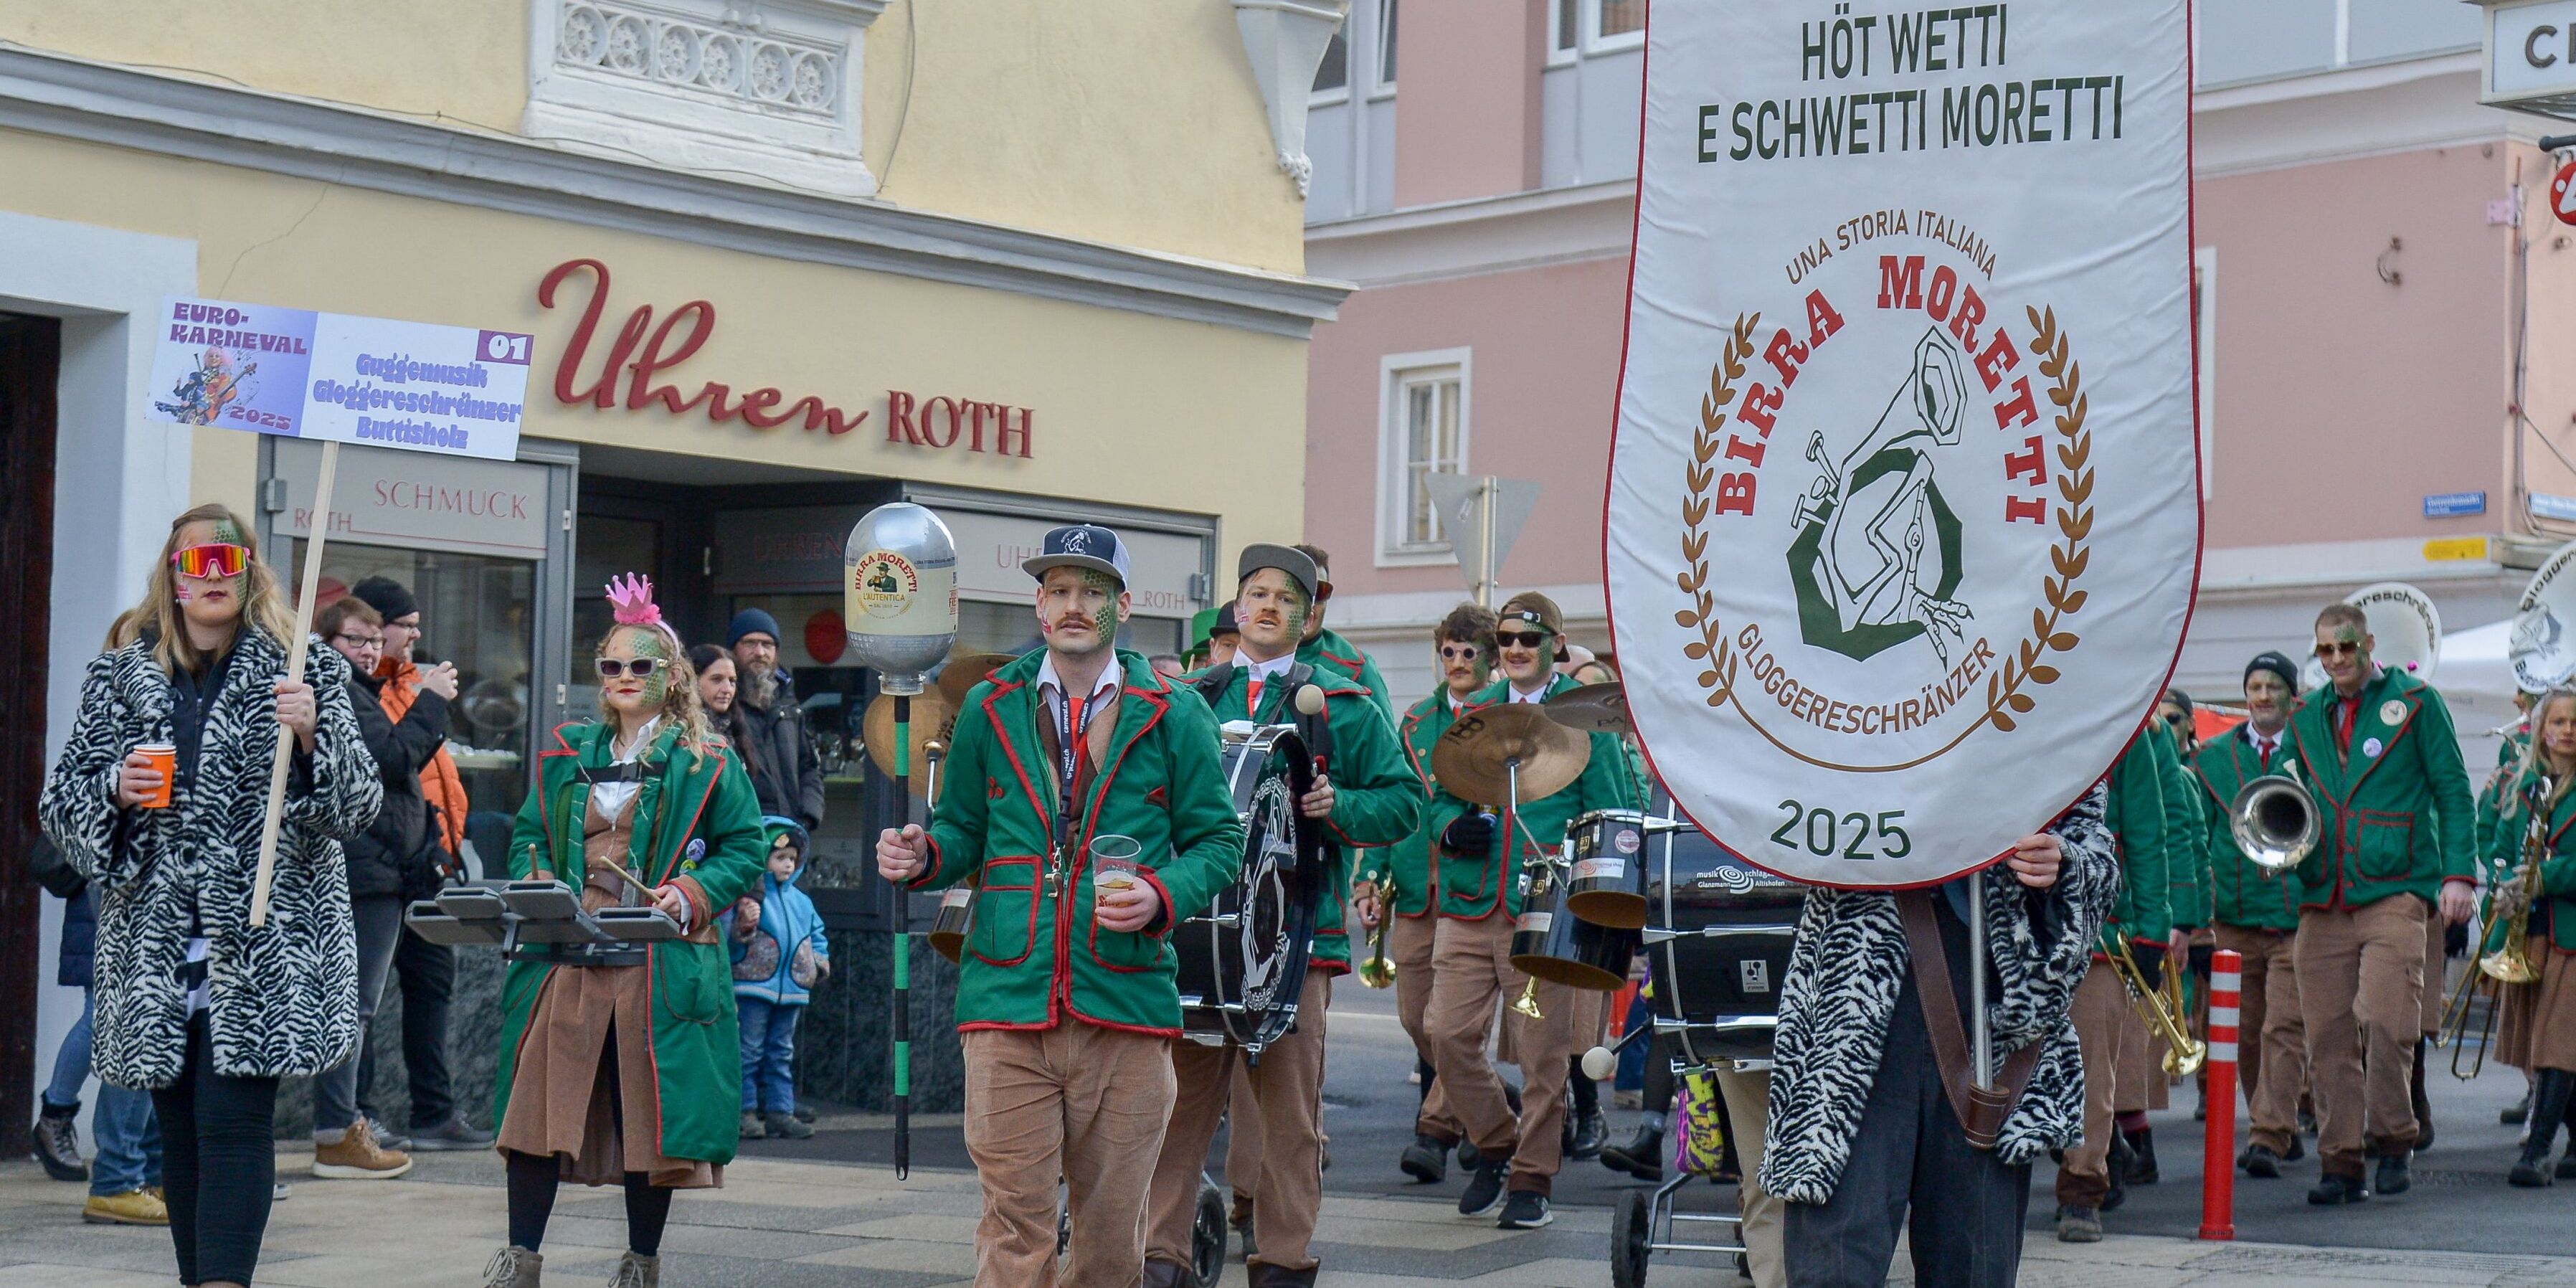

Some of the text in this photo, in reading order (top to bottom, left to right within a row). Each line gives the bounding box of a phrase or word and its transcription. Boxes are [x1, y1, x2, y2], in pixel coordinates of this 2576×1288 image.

[1801, 2, 2007, 81] HÖT WETTI
[1697, 75, 2124, 164] E SCHWETTI MORETTI
[1786, 209, 1998, 285] UNA STORIA ITALIANA
[173, 301, 250, 326] EURO-
[169, 324, 308, 355] KARNEVAL
[488, 334, 530, 360] 01
[539, 257, 1036, 460] Uhren ROTH
[356, 352, 488, 389] Guggemusik
[1715, 255, 2049, 526] BIRRA MORETTI
[229, 405, 292, 430] 2025
[313, 379, 522, 423] Gloggereschränzer
[356, 416, 469, 450] Buttisholz
[374, 478, 529, 521] SCHMUCK
[293, 508, 353, 532] RTH
[855, 552, 918, 592] BIRRA MORETTI
[863, 593, 906, 602] L'AUTENTICA
[1145, 590, 1185, 610] ROTH
[1738, 622, 1997, 735] GLOGGERESCHRÄNZER
[1769, 799, 1912, 861] 2025
